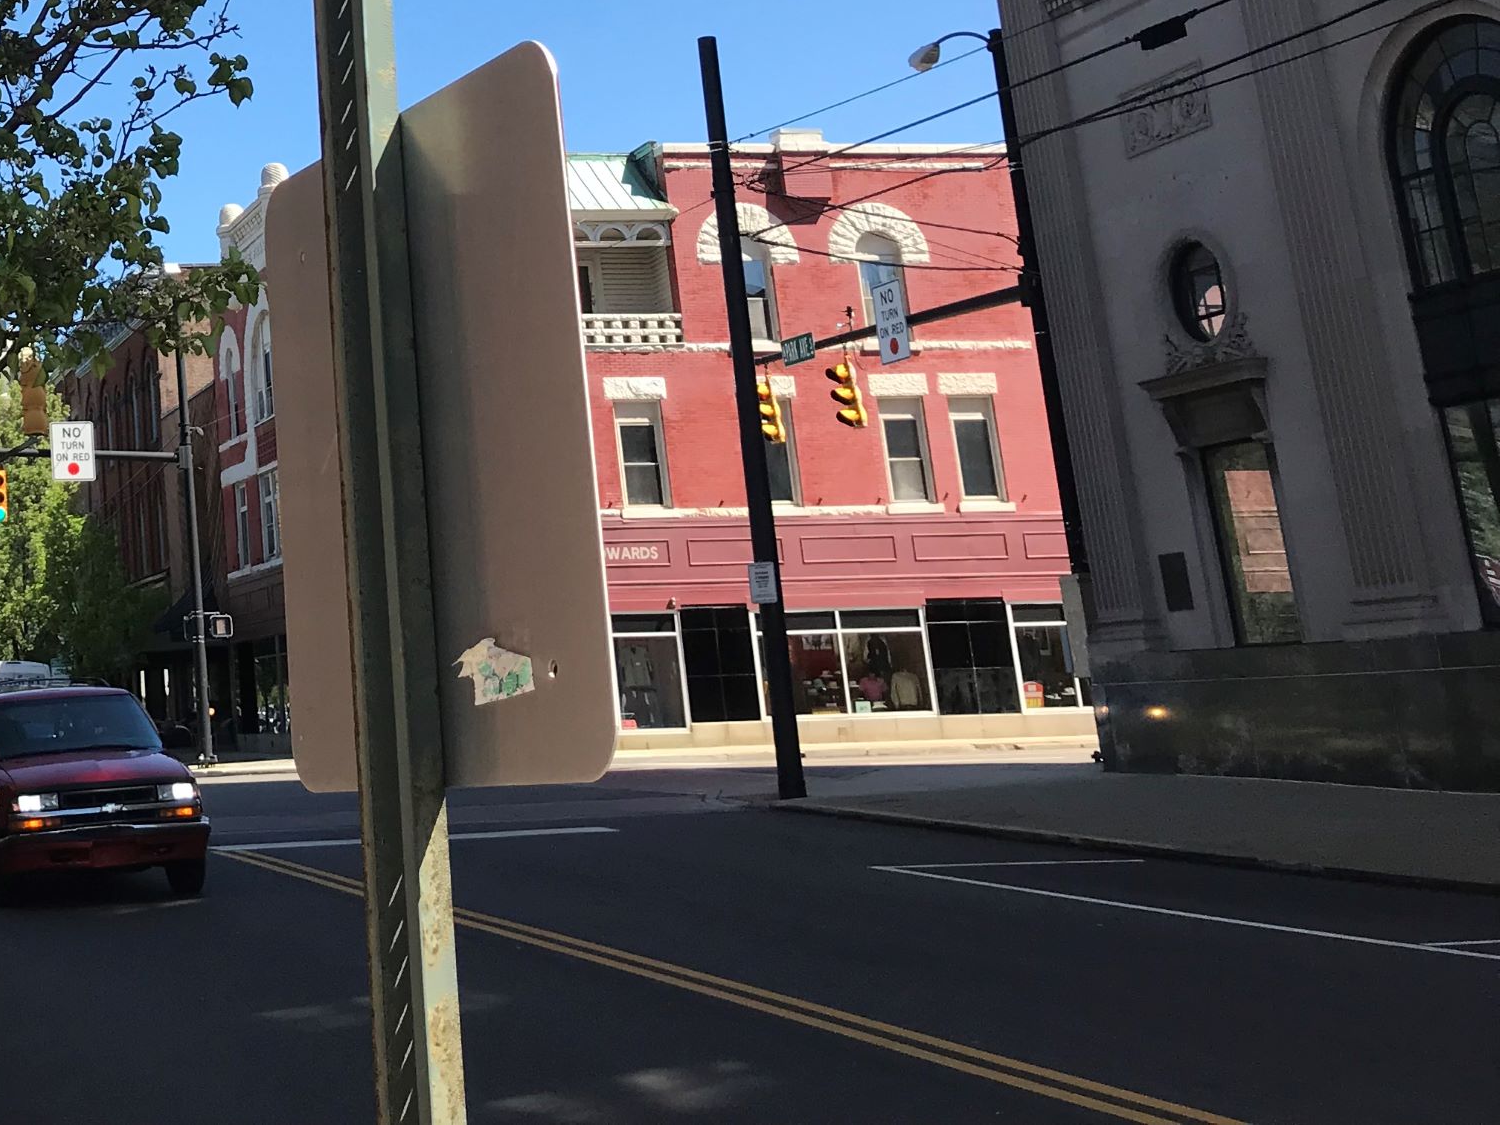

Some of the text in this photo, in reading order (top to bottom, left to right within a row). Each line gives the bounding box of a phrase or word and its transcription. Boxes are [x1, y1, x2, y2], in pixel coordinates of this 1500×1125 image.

[880, 288, 894, 306] NO
[881, 307, 899, 322] TURN
[880, 321, 904, 339] ON RED
[62, 427, 81, 438] NO
[61, 441, 85, 450] TURN
[56, 452, 90, 462] ON RED
[604, 546, 659, 560] WARDS
